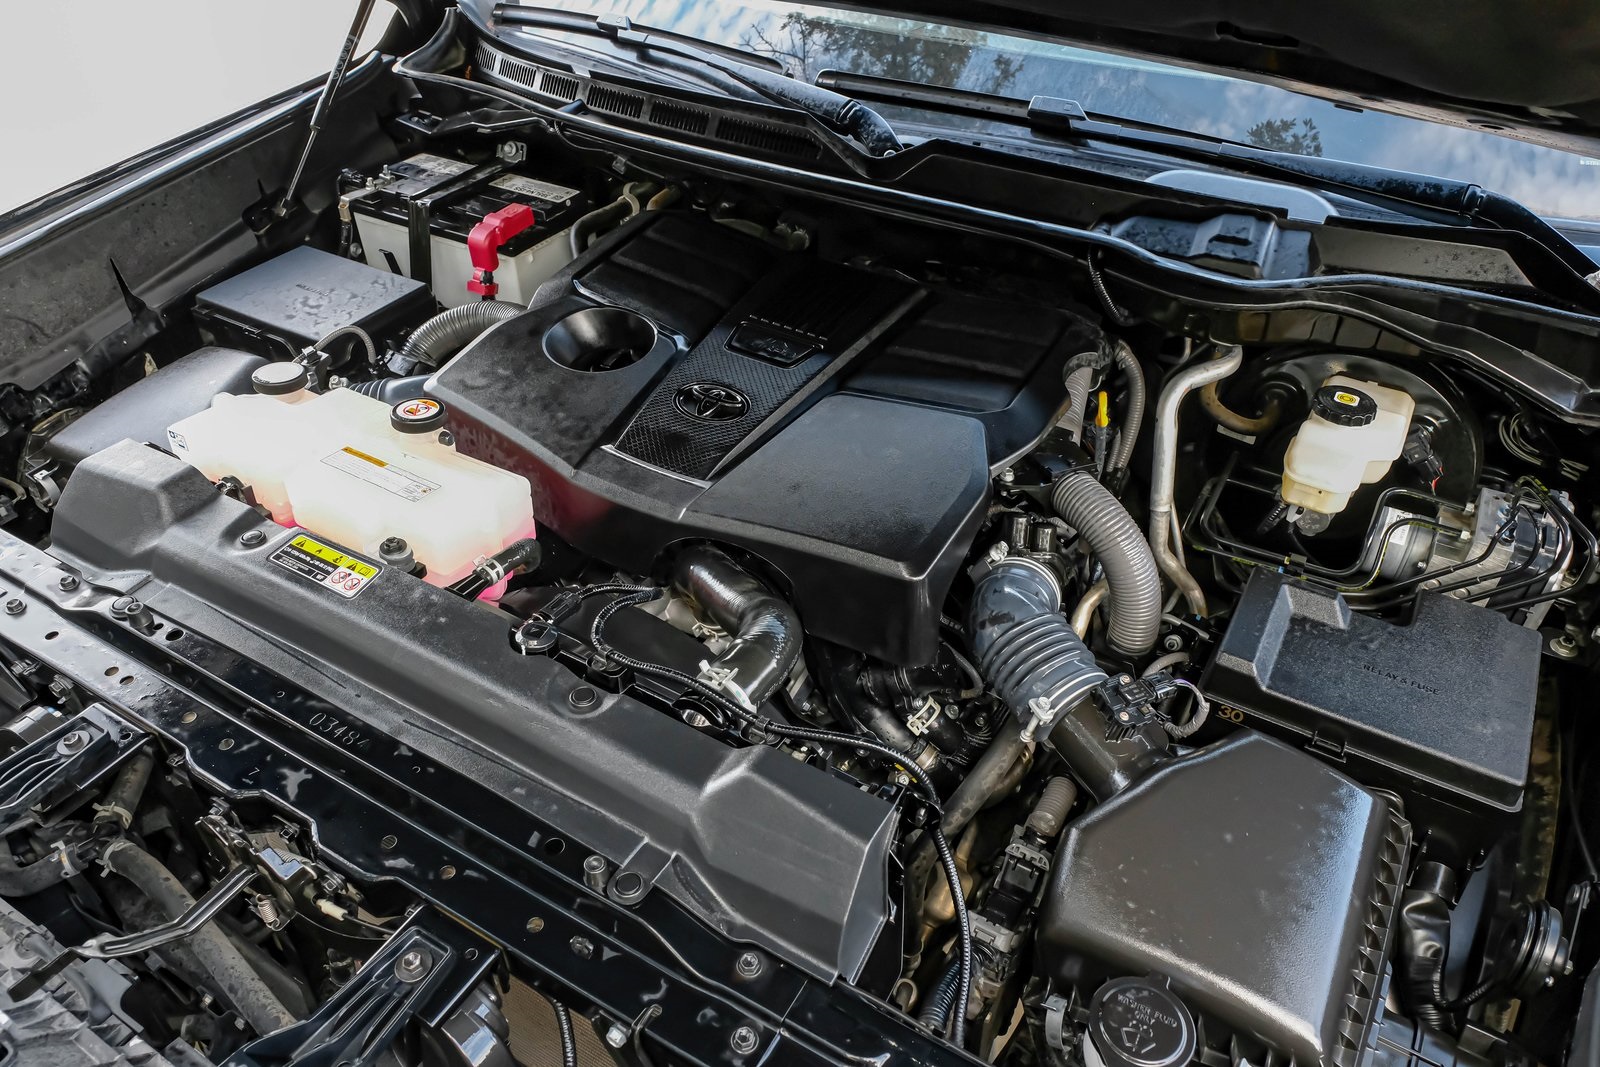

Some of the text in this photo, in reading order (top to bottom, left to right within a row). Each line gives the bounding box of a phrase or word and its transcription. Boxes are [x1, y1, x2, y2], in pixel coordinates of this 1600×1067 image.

[1363, 664, 1399, 680] RELAY
[1410, 680, 1440, 695] FUSE
[1218, 704, 1244, 722] 30
[1134, 1010, 1156, 1026] ONLY
[1154, 1011, 1178, 1028] FLUID
